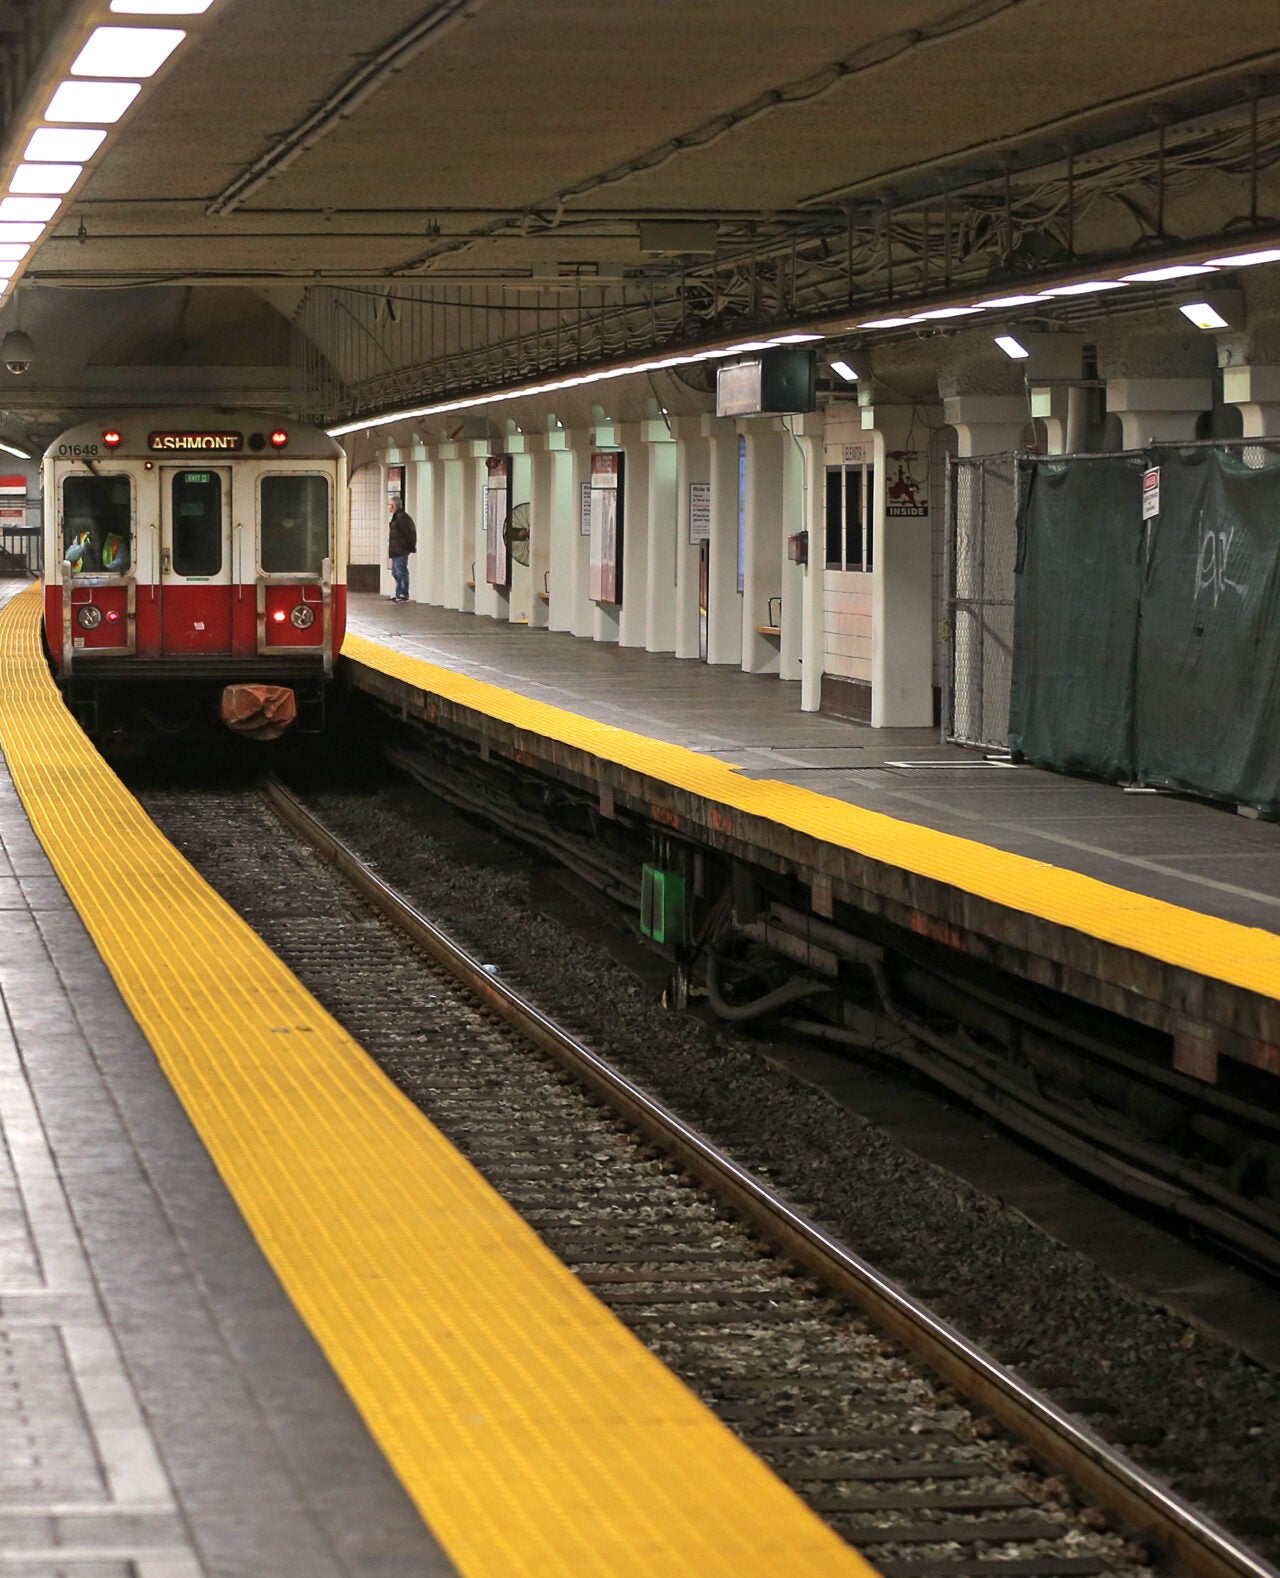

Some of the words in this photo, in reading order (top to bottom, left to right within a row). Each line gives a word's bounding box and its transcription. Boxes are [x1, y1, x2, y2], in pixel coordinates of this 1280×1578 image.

[152, 436, 238, 449] ASHMONT
[59, 444, 99, 456] 01648
[890, 507, 925, 516] INSIDE
